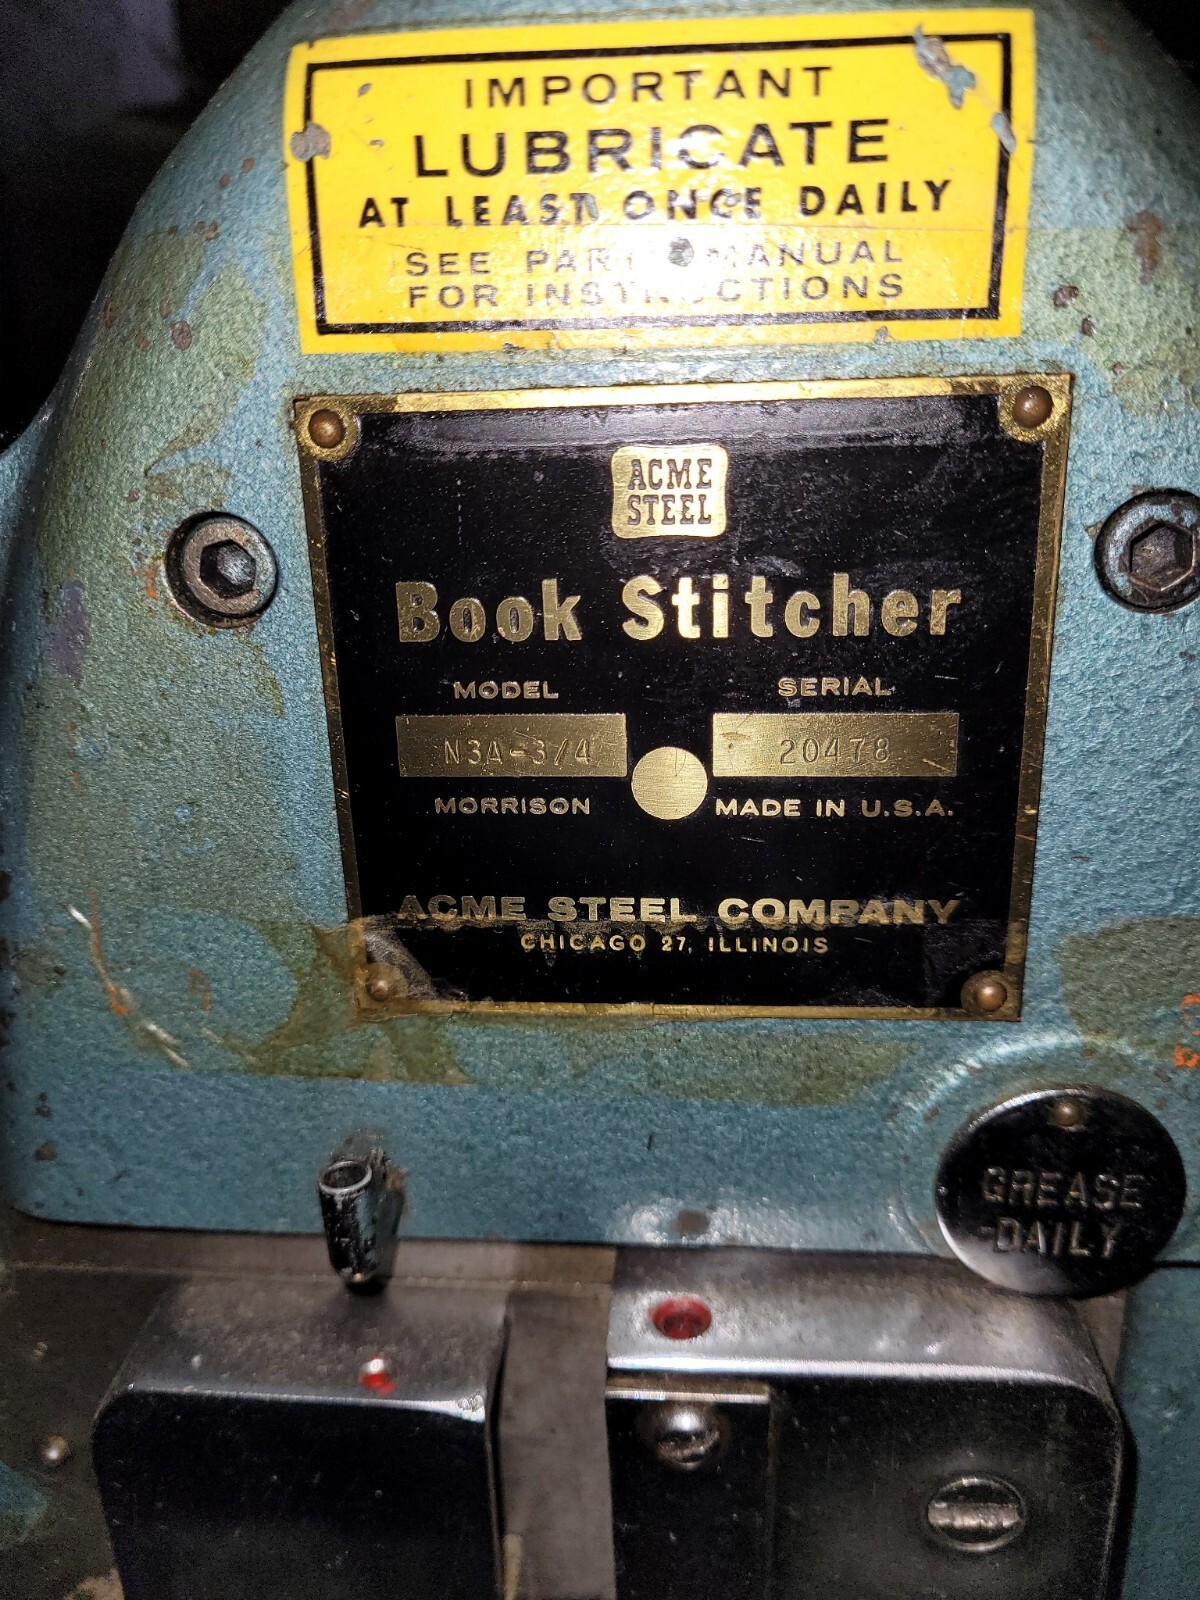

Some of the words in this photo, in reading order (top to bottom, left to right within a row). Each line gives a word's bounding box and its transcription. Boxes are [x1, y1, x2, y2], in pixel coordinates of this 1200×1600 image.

[465, 66, 832, 109] IMPORTANT
[415, 118, 889, 178] LUBRICATE
[359, 197, 409, 228] AT
[446, 191, 596, 227] LEAST
[623, 186, 762, 220] ONCE
[800, 179, 951, 217] DAILY
[406, 251, 491, 277] SEE
[526, 246, 674, 274] PAR
[409, 284, 499, 309] FOR
[526, 272, 902, 307] INSTCTIONS
[628, 458, 712, 490] ACME
[627, 494, 712, 525] STEEL
[394, 578, 582, 643] Book
[622, 573, 962, 641] Stitcher
[453, 680, 559, 700] MODEL
[778, 676, 892, 697] SERIAL
[780, 735, 890, 765] 20478
[434, 797, 591, 816] MORRISON
[715, 798, 801, 817] MADE
[816, 799, 846, 817] IN
[861, 799, 955, 819] U.S.A.
[397, 895, 527, 921] ACME
[548, 896, 697, 922] STEEL
[718, 897, 961, 926] COMPANY
[520, 934, 647, 953] CHICAGO
[661, 936, 693, 955] 27,
[708, 936, 829, 954] ILLINOIS
[981, 1166, 1147, 1211] GREASE
[996, 1216, 1121, 1260] DAILY
